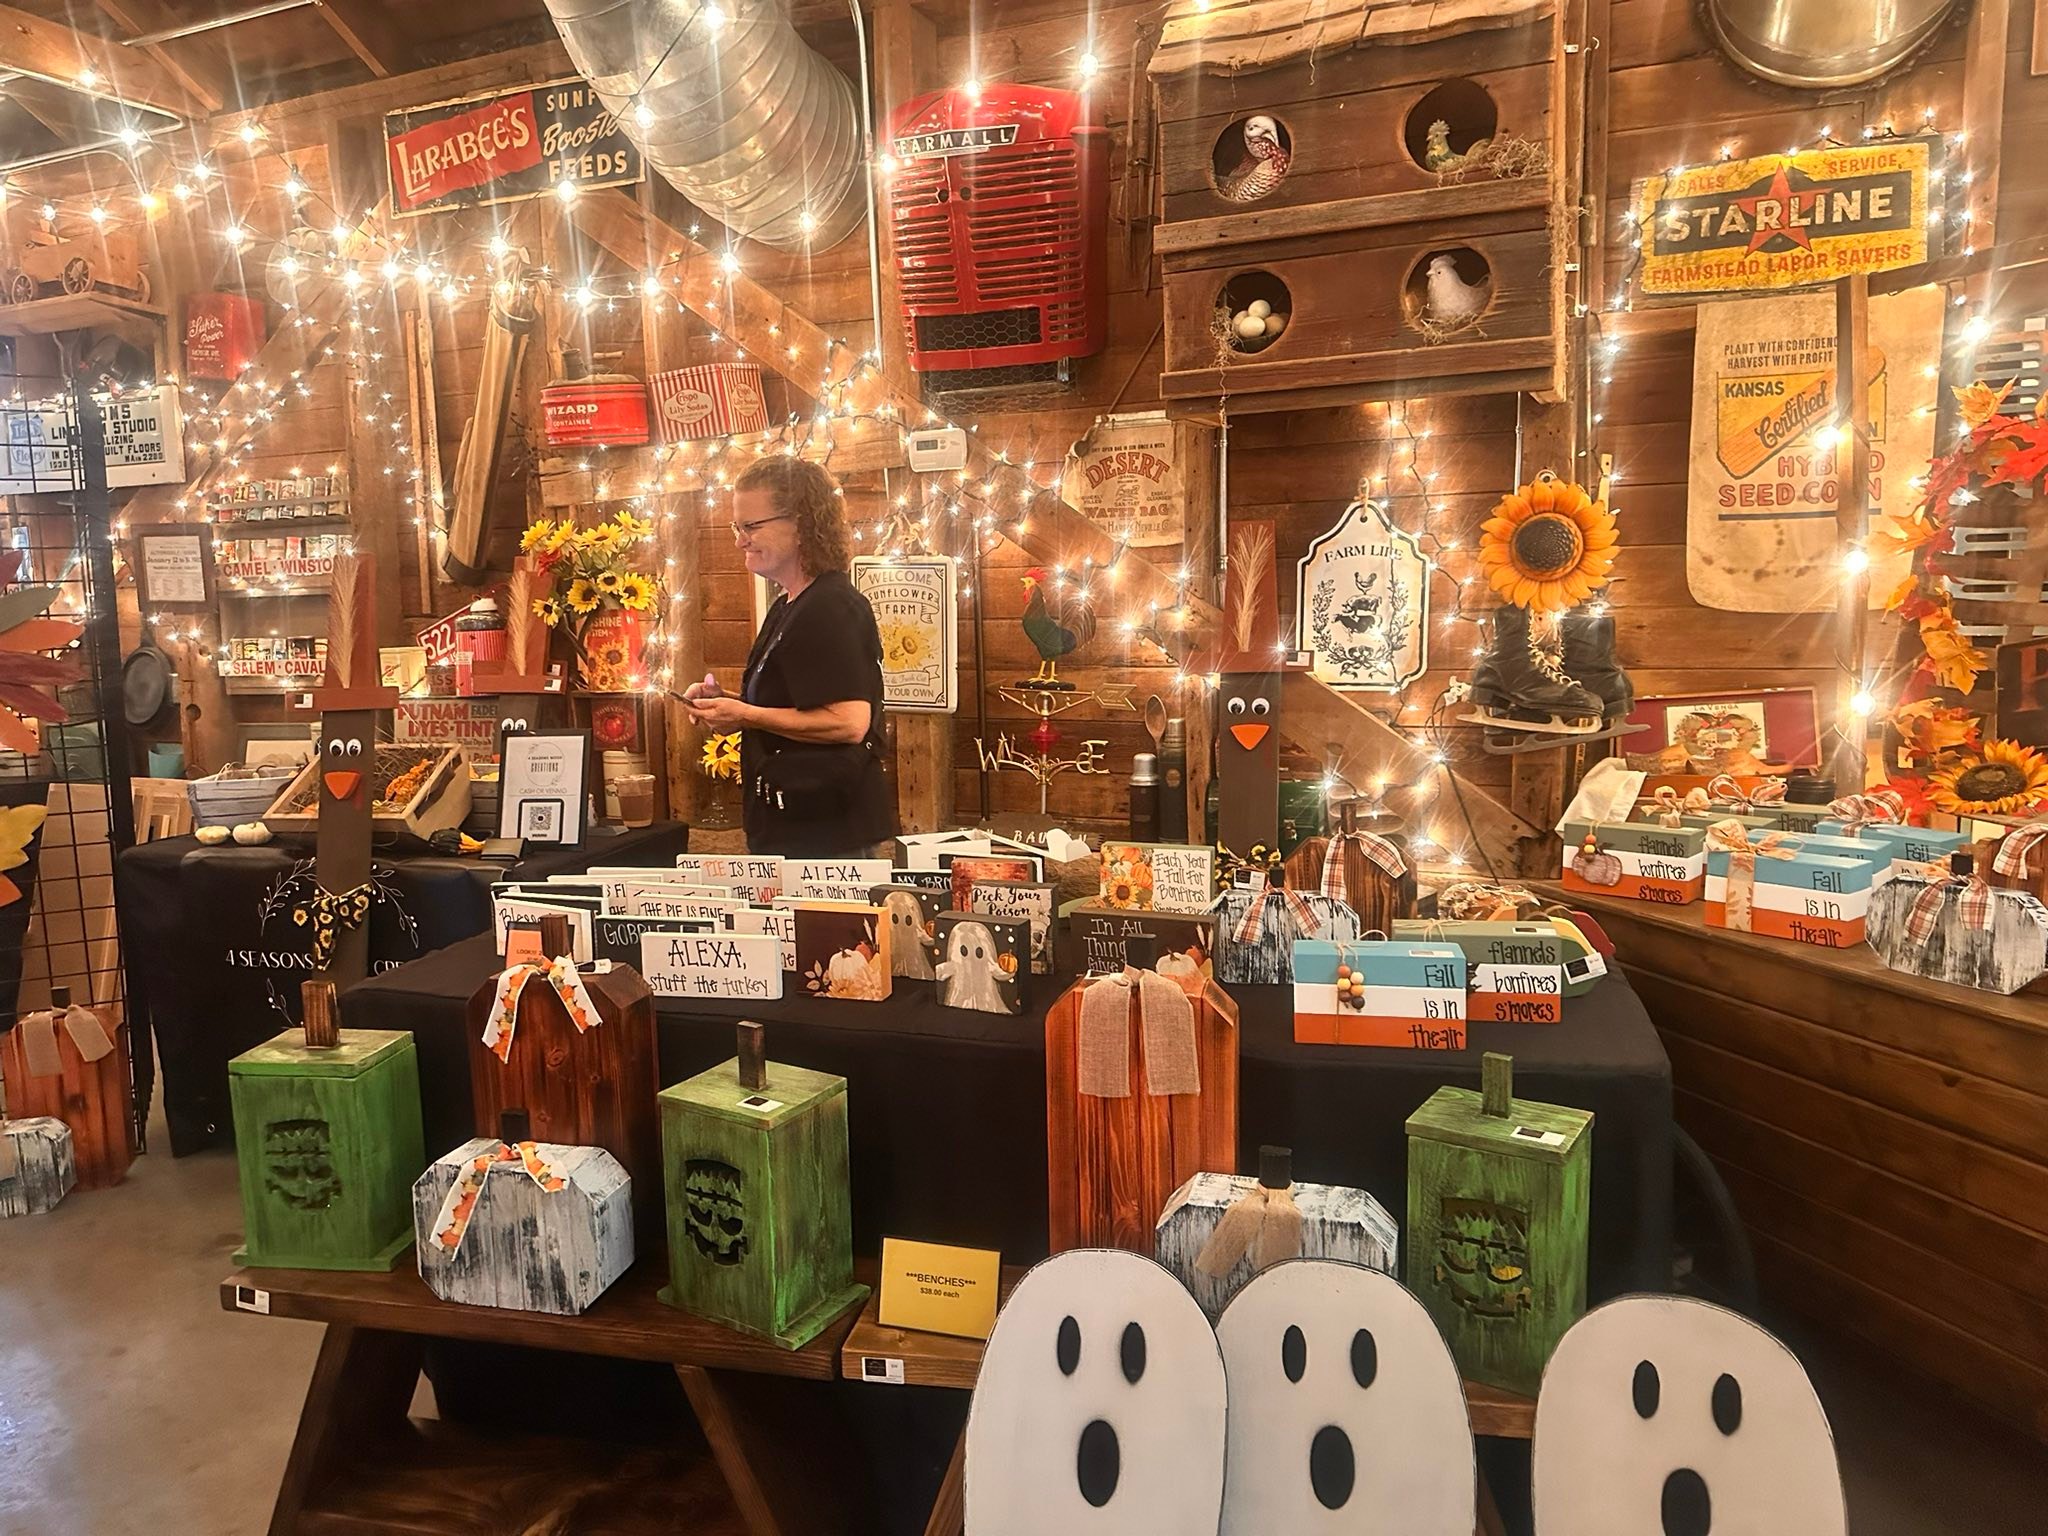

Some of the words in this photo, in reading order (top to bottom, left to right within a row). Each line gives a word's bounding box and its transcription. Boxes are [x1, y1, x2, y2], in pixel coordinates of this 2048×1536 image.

[546, 88, 600, 113] SUNF
[899, 128, 1010, 155] FARMALL
[549, 150, 628, 184] FEEDS
[1677, 175, 1727, 192] SALES
[1828, 154, 1898, 174] SERVICE
[1658, 186, 1895, 243] STARLINE
[1651, 259, 1761, 285] FARMSTEAD
[1767, 251, 1828, 273] LABOR
[1836, 244, 1912, 267] SAVERS
[1724, 342, 1755, 356] PLANT
[1758, 341, 1784, 354] WITH
[1727, 355, 1769, 369] HARVEST
[1772, 353, 1797, 366] WITH
[1799, 350, 1834, 364] PROFIT
[1725, 381, 1785, 398] KANSAS
[113, 417, 157, 435] STUDIO
[127, 442, 162, 454] FLOORS
[1085, 451, 1171, 490] DESERT
[1718, 482, 1796, 507] SEED
[1803, 477, 1882, 504] CON
[1084, 506, 1136, 519] WATER
[1139, 503, 1169, 517] BAG
[1324, 544, 1367, 564] FARM
[223, 562, 272, 577] CAMEL
[280, 557, 333, 574] WINSTO
[867, 569, 933, 586] WELCOME
[868, 587, 935, 603] SUNFLOWER
[885, 604, 916, 616] FARM
[593, 615, 623, 628] SHINE
[233, 660, 275, 674] SALEM
[284, 660, 326, 674] CAVAL
[888, 687, 911, 698] YOUR
[912, 687, 935, 699] OWN
[397, 703, 469, 720] PUTNAM
[703, 860, 727, 878] PIE
[728, 860, 745, 878] IS
[748, 861, 778, 879] FINE
[1154, 851, 1183, 869] Each
[1183, 854, 1208, 870] Year
[1638, 858, 1687, 881] bonfires
[1163, 868, 1185, 885] Fall
[1186, 869, 1206, 887] For
[1812, 870, 1842, 894] Fall
[732, 885, 755, 902] THE
[804, 884, 824, 899] The
[848, 886, 871, 901] Thin
[972, 887, 1004, 904] Pick
[1007, 886, 1041, 905] Your
[987, 902, 1032, 916] Poison
[1805, 896, 1819, 916] is
[1823, 897, 1841, 921] in
[762, 916, 797, 943] ALE
[1090, 918, 1115, 936] In
[1120, 919, 1143, 936] All
[668, 938, 748, 971] ALEXA,
[1082, 935, 1128, 965] Thing
[1488, 941, 1557, 966] flannels
[225, 949, 235, 967] 4
[239, 950, 316, 971] SEASONS
[1424, 963, 1456, 988] Fall
[1493, 970, 1558, 995] bonfires
[649, 973, 687, 992] stuff
[693, 975, 718, 994] the
[722, 975, 769, 998] turkey
[1423, 997, 1439, 1019] is
[1443, 998, 1458, 1020] in
[919, 1286, 942, 1297] $38.00
[942, 1290, 961, 1299] each
